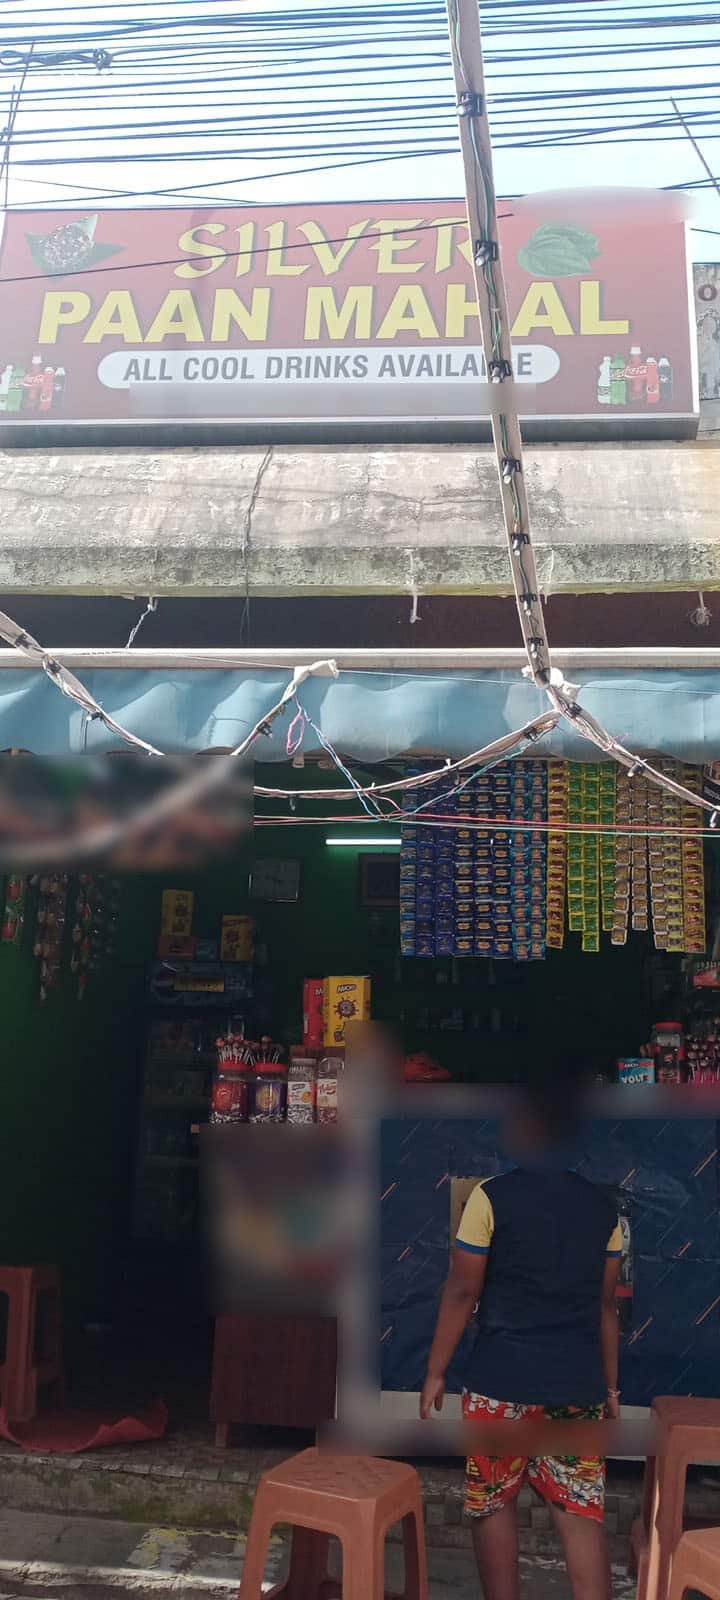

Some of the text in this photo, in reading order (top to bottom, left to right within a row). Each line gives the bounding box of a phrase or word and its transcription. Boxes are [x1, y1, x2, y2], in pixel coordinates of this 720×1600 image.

[38, 287, 271, 344] PAAN
[123, 352, 533, 381] ALL COOL DRINKS AVAILAE
